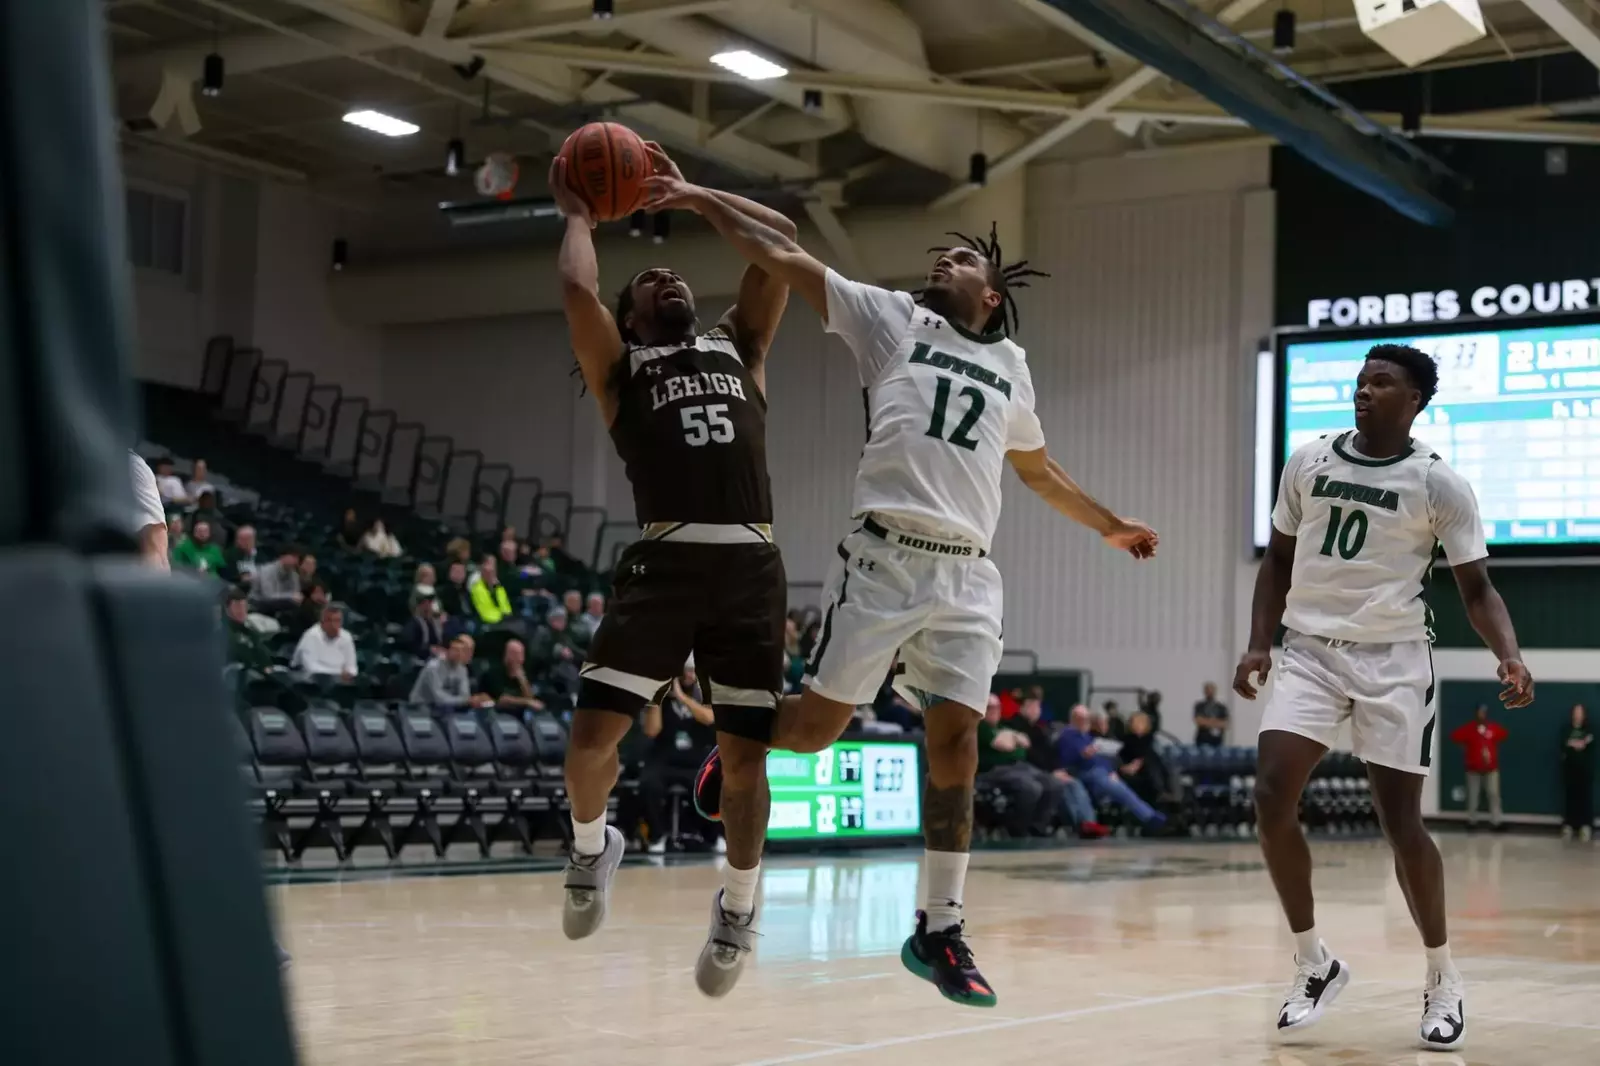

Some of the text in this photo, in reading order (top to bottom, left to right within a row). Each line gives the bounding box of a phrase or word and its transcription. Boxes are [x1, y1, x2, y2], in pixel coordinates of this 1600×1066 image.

[1307, 289, 1460, 328] FORBES
[650, 372, 747, 411] LEHIGH
[908, 341, 1012, 401] LOYOLA
[680, 403, 735, 447] 55
[925, 375, 986, 451] 12
[1311, 475, 1399, 511] LOYOLA
[898, 535, 973, 556] HOUNDS
[1319, 505, 1369, 560] 10
